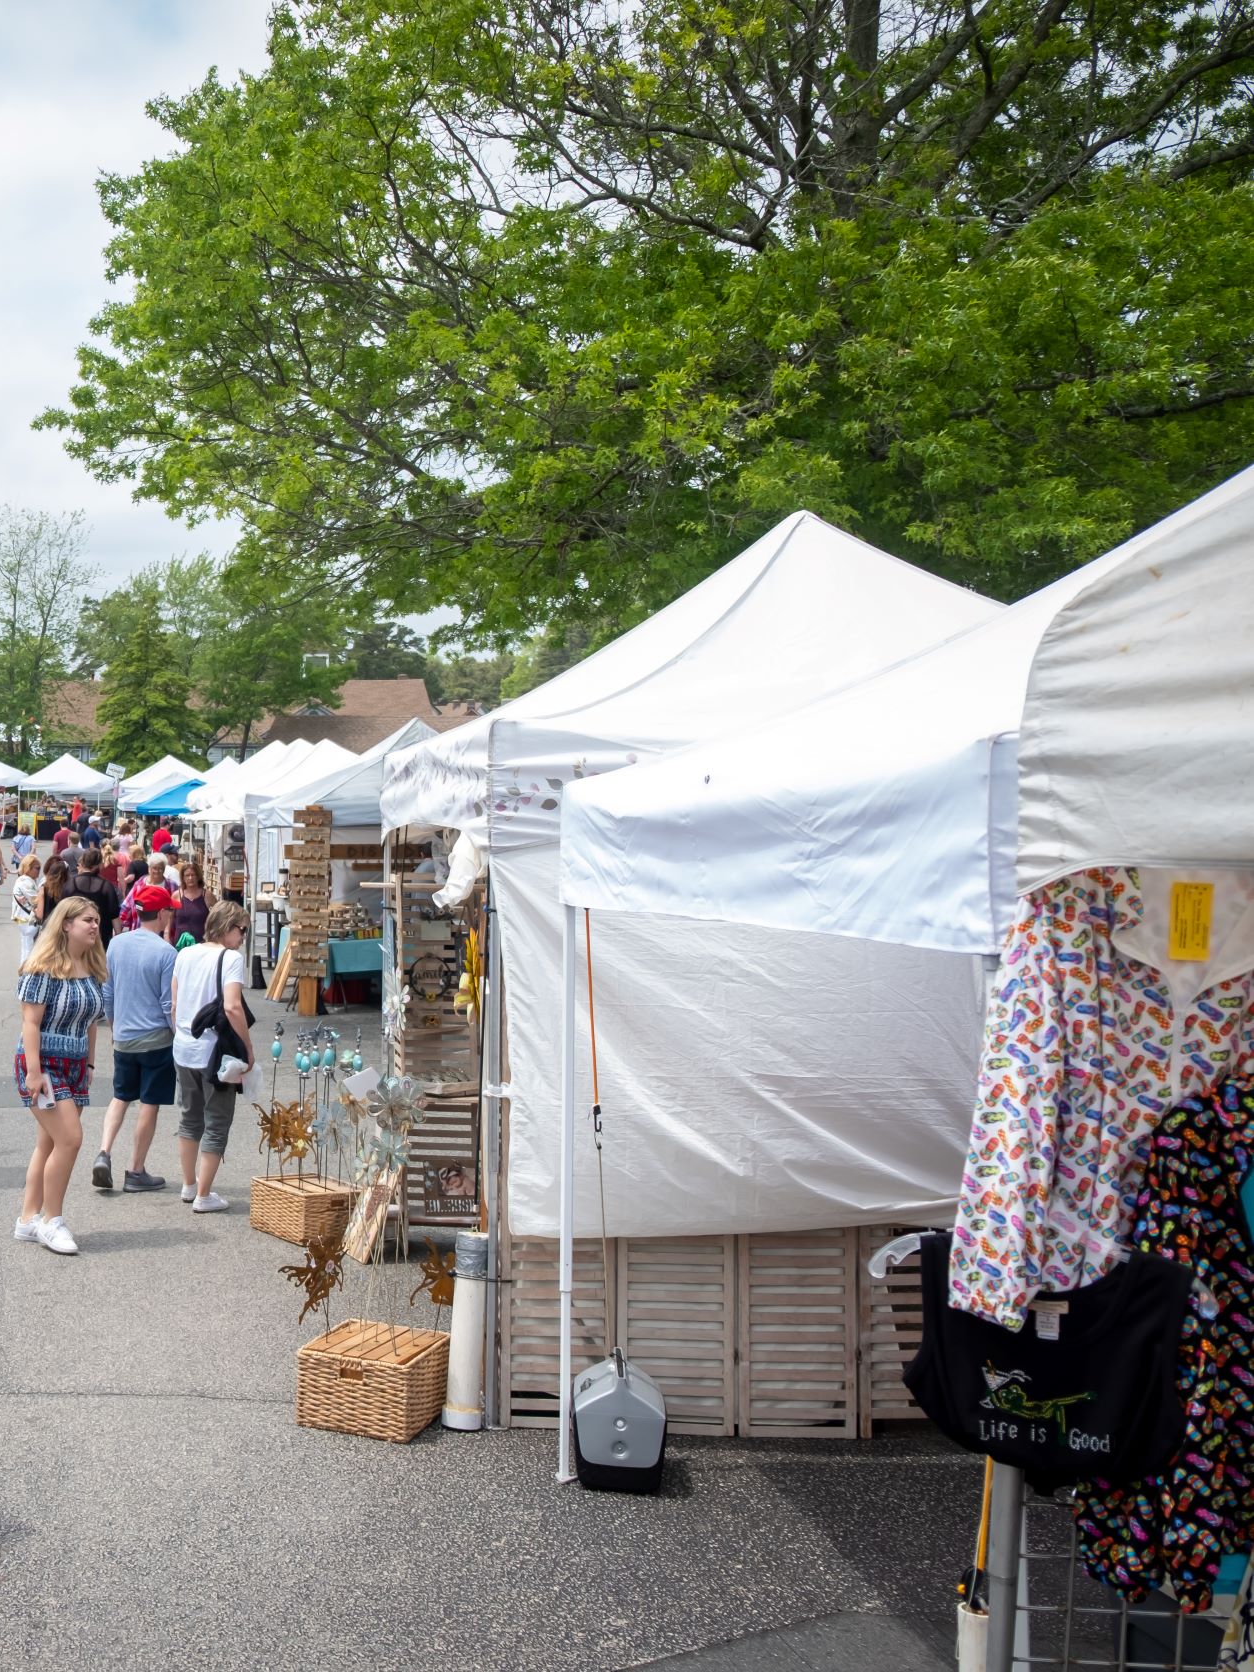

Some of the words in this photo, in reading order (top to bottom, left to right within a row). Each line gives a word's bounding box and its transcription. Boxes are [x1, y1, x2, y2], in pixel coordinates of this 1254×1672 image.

[978, 1419, 1018, 1442] Life
[1029, 1423, 1047, 1444] is
[1068, 1428, 1110, 1453] Good
